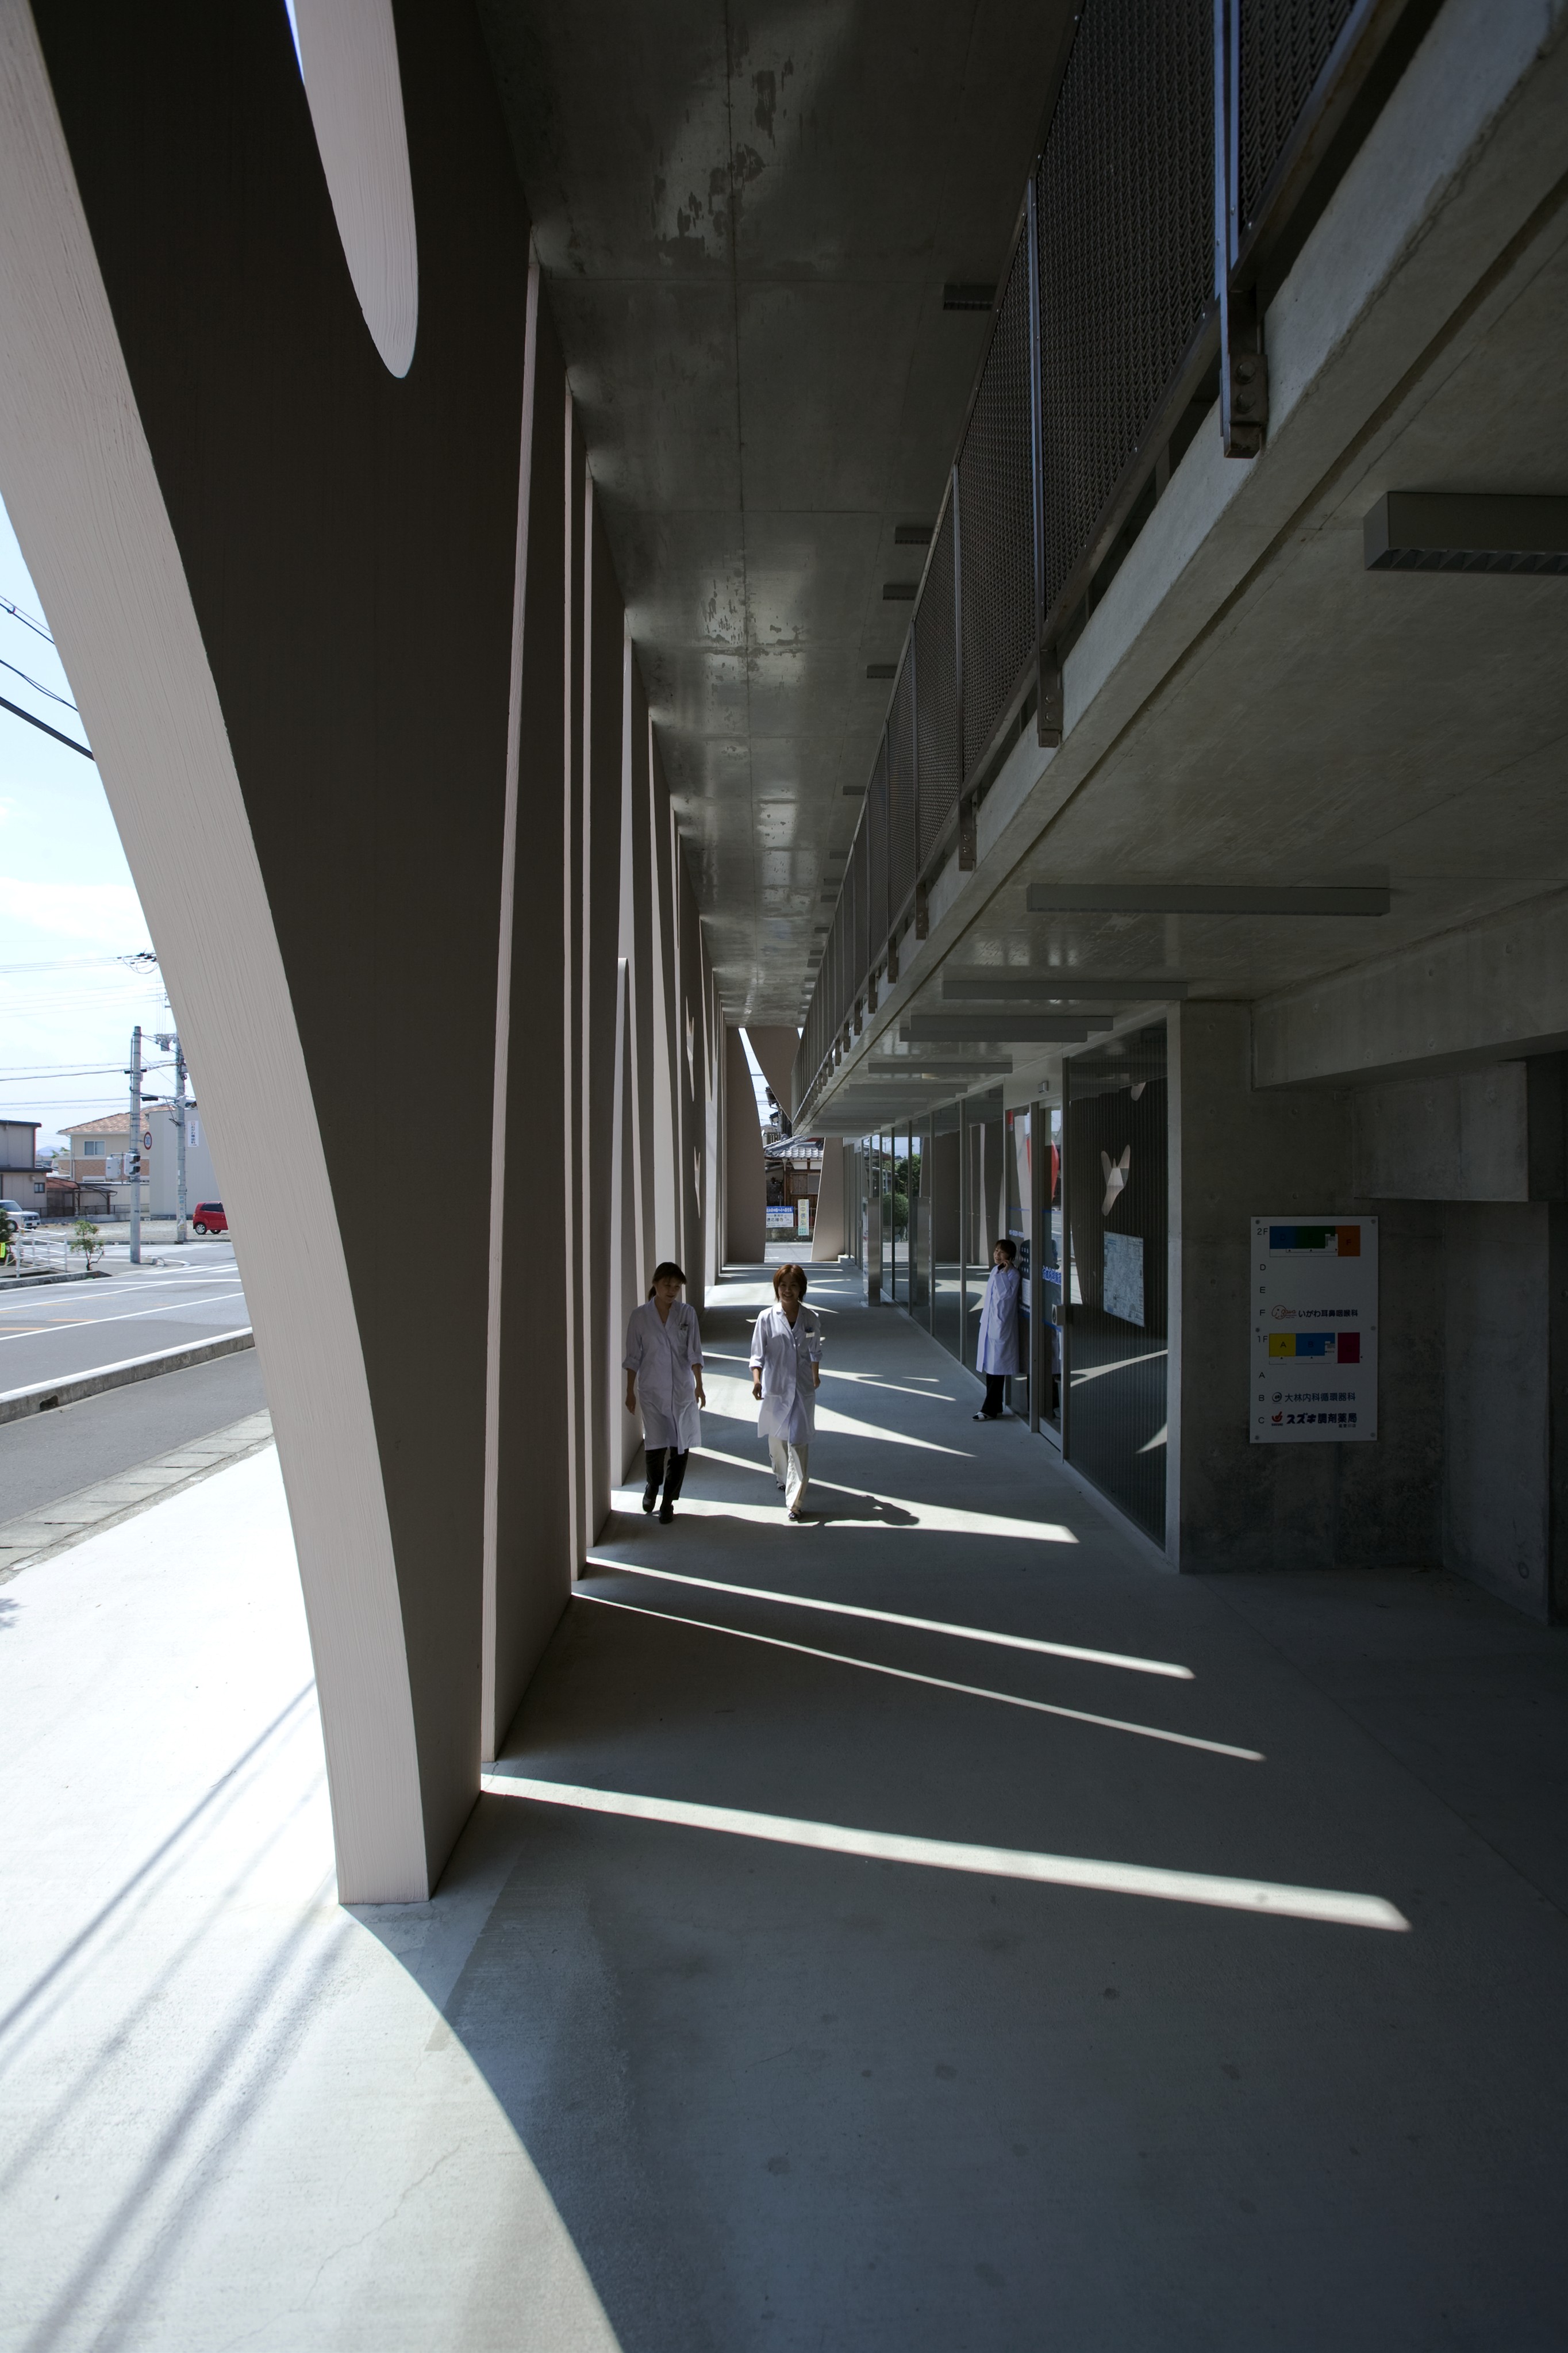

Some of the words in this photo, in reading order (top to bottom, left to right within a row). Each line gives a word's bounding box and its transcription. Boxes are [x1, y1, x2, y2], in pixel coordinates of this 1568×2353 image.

[1298, 1309, 1358, 1318] いがわ耳鼻咽喉科
[1285, 1392, 1355, 1402] 大林内科循環器科
[1286, 1412, 1357, 1424] スズキ調剤薬局
